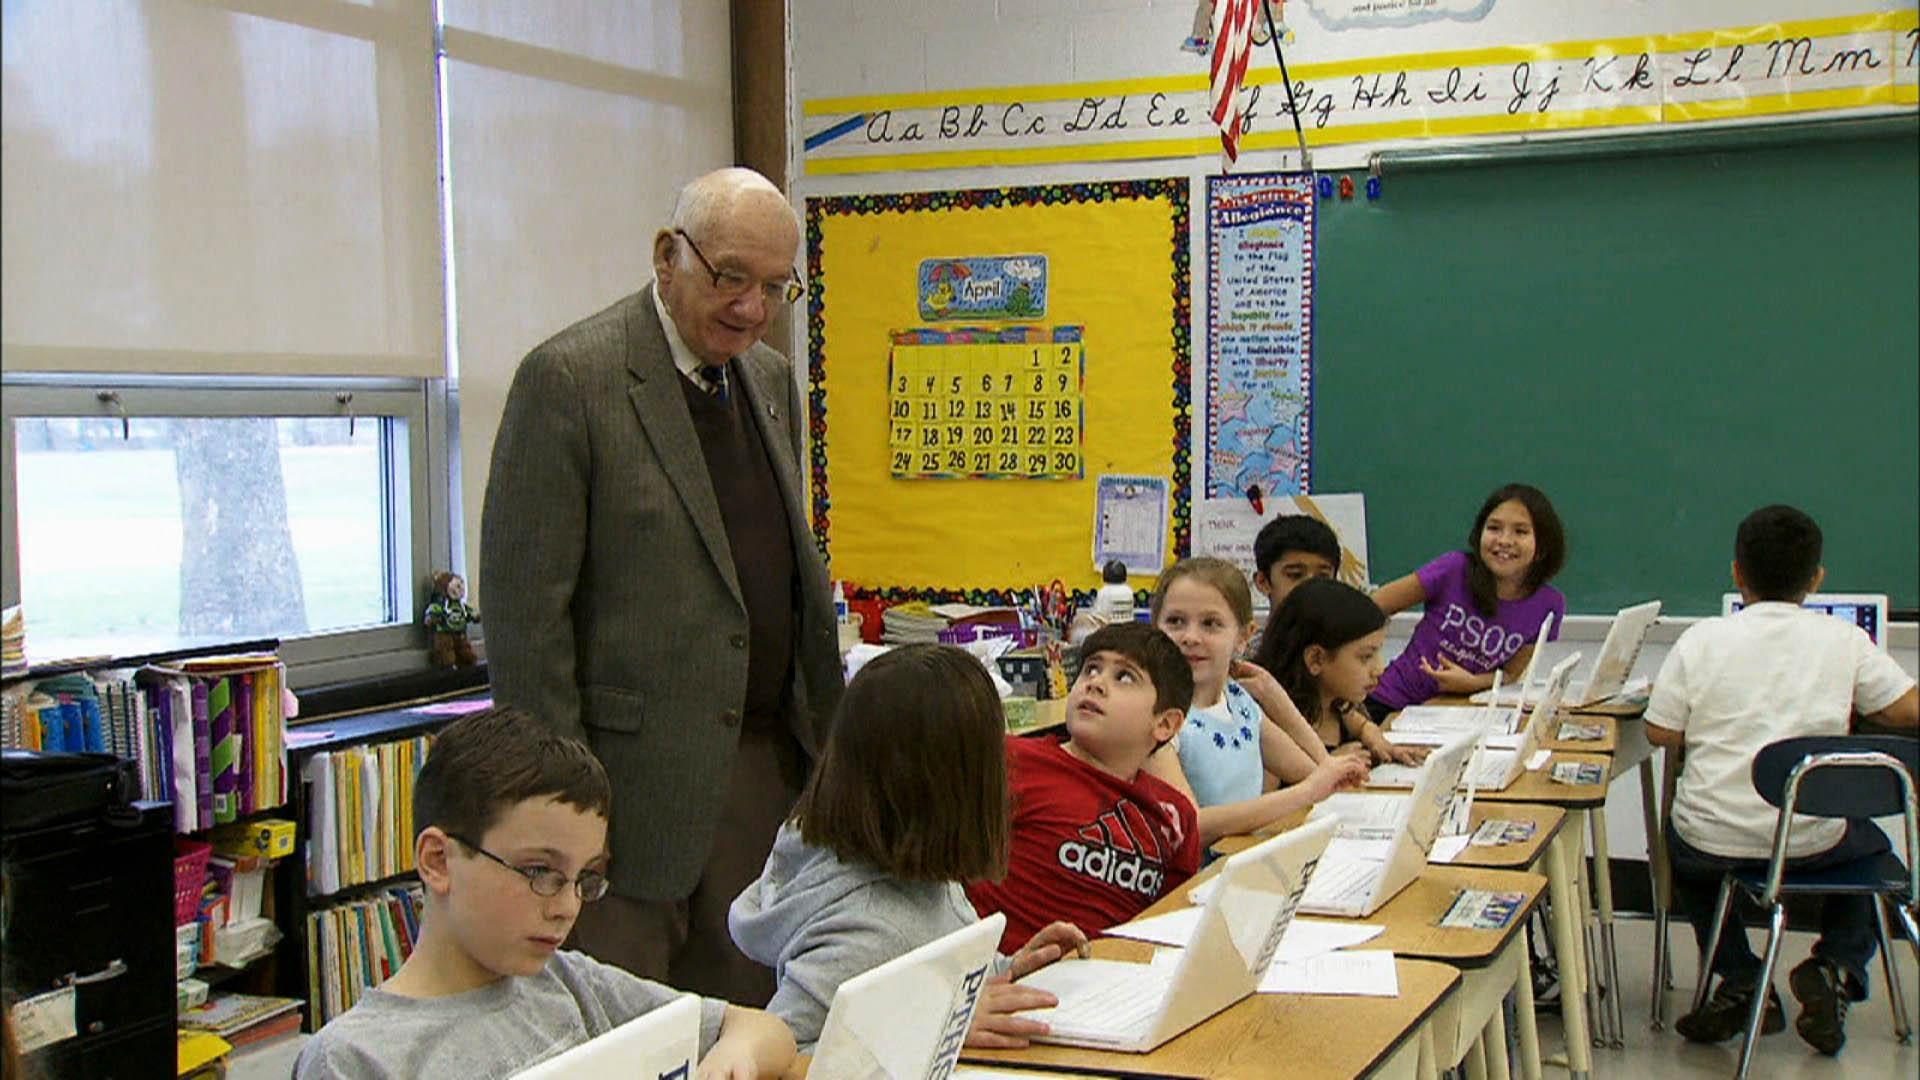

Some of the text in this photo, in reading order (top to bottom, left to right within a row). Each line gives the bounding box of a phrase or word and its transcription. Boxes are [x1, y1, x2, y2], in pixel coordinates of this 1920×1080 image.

[866, 110, 924, 142] Aa
[938, 104, 988, 138] Bb
[1001, 102, 1046, 136] Cc
[1063, 95, 1128, 133] Dd
[1146, 92, 1190, 127] Ee
[1240, 85, 1258, 135] f
[1352, 71, 1412, 110] Hh
[1427, 67, 1487, 104] Ii
[1507, 62, 1563, 114] Jj
[1583, 52, 1653, 93] Kk
[1672, 44, 1744, 87] Ll
[1766, 37, 1881, 79] Mm
[1219, 203, 1303, 225] Allegiance
[963, 279, 1001, 301] April
[1226, 276, 1295, 285] United States
[1032, 346, 1071, 367] 1 2
[897, 374, 1068, 394] 3 4 5 6 7 8 9
[893, 400, 1071, 421] 10 11 12 13 14 15 16
[896, 426, 1074, 446] 17 18 19 20 21 22 23
[893, 450, 1076, 473] 24 25 26 27 28 29 30
